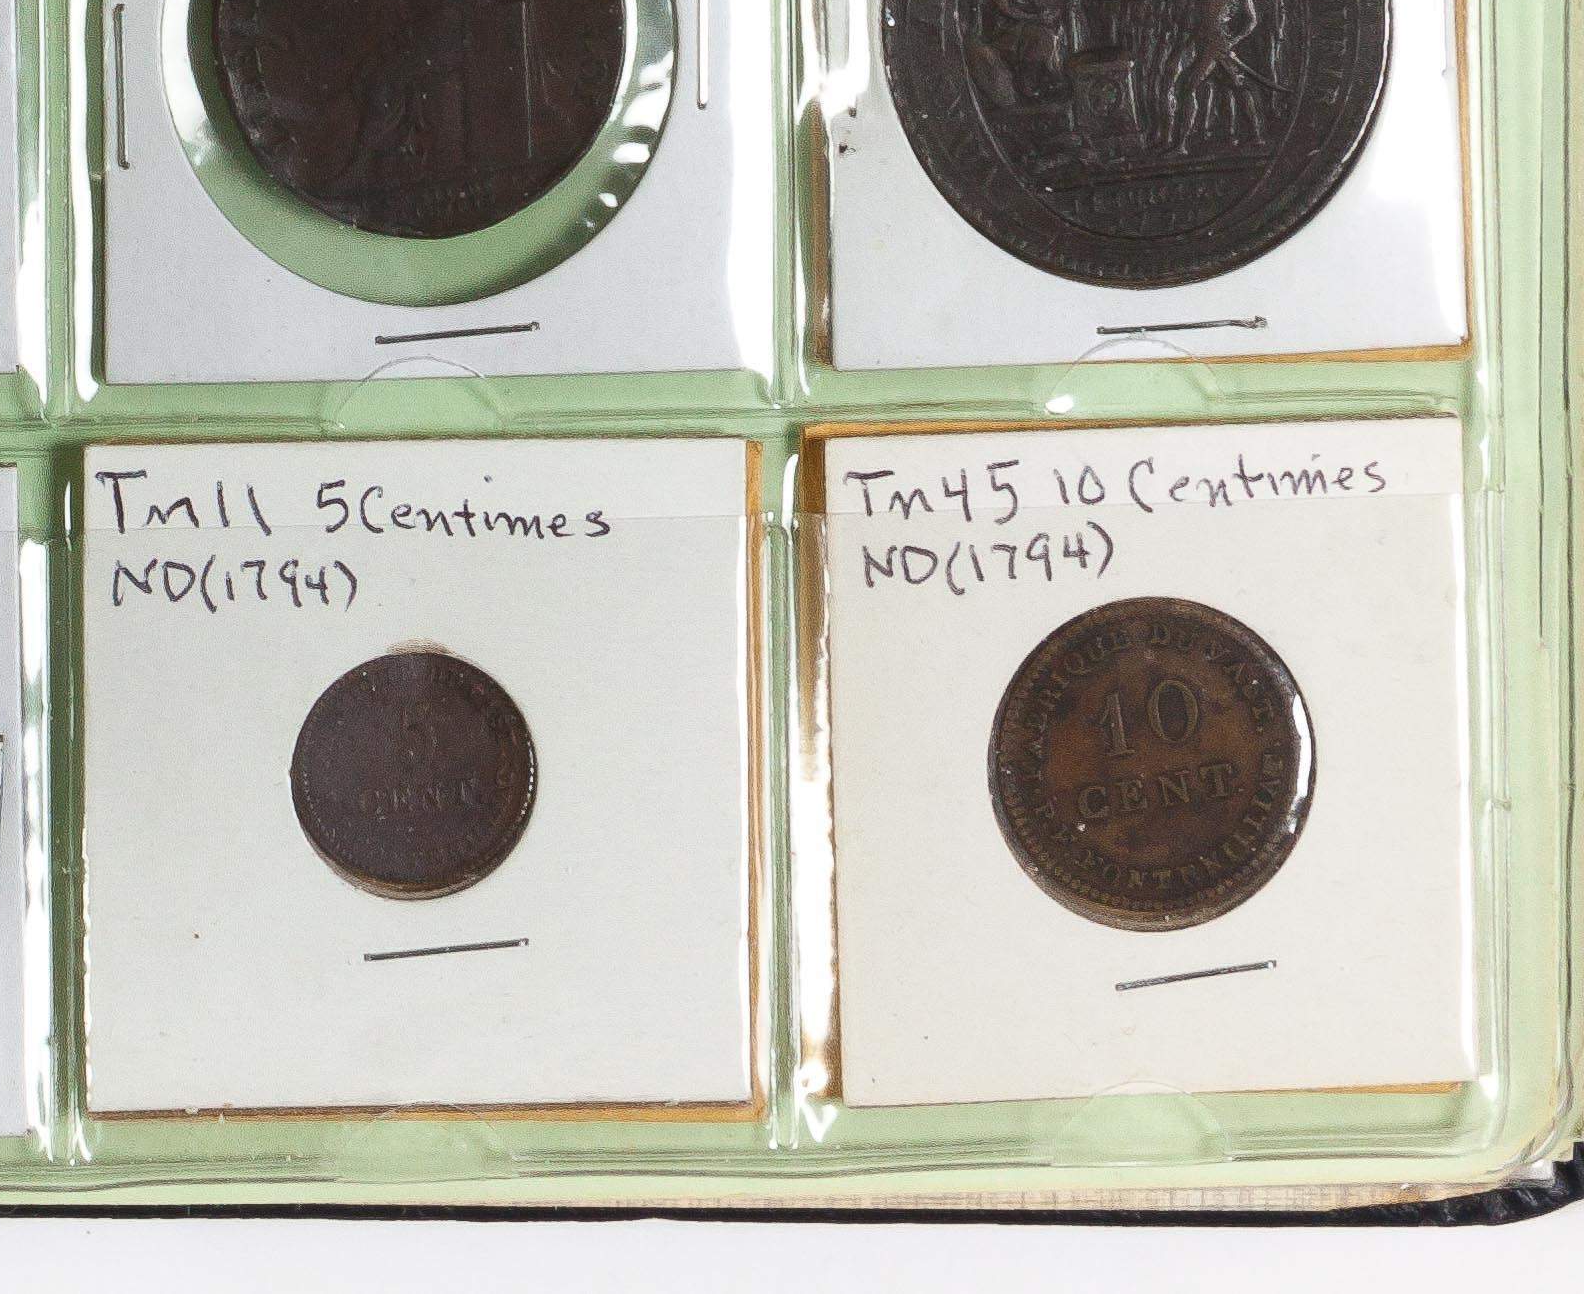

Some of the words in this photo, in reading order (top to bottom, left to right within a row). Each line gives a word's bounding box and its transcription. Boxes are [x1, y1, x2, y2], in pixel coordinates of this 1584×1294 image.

[1053, 465, 1106, 506] 10
[1127, 453, 1387, 514] Centimes
[1100, 677, 1200, 761] 10
